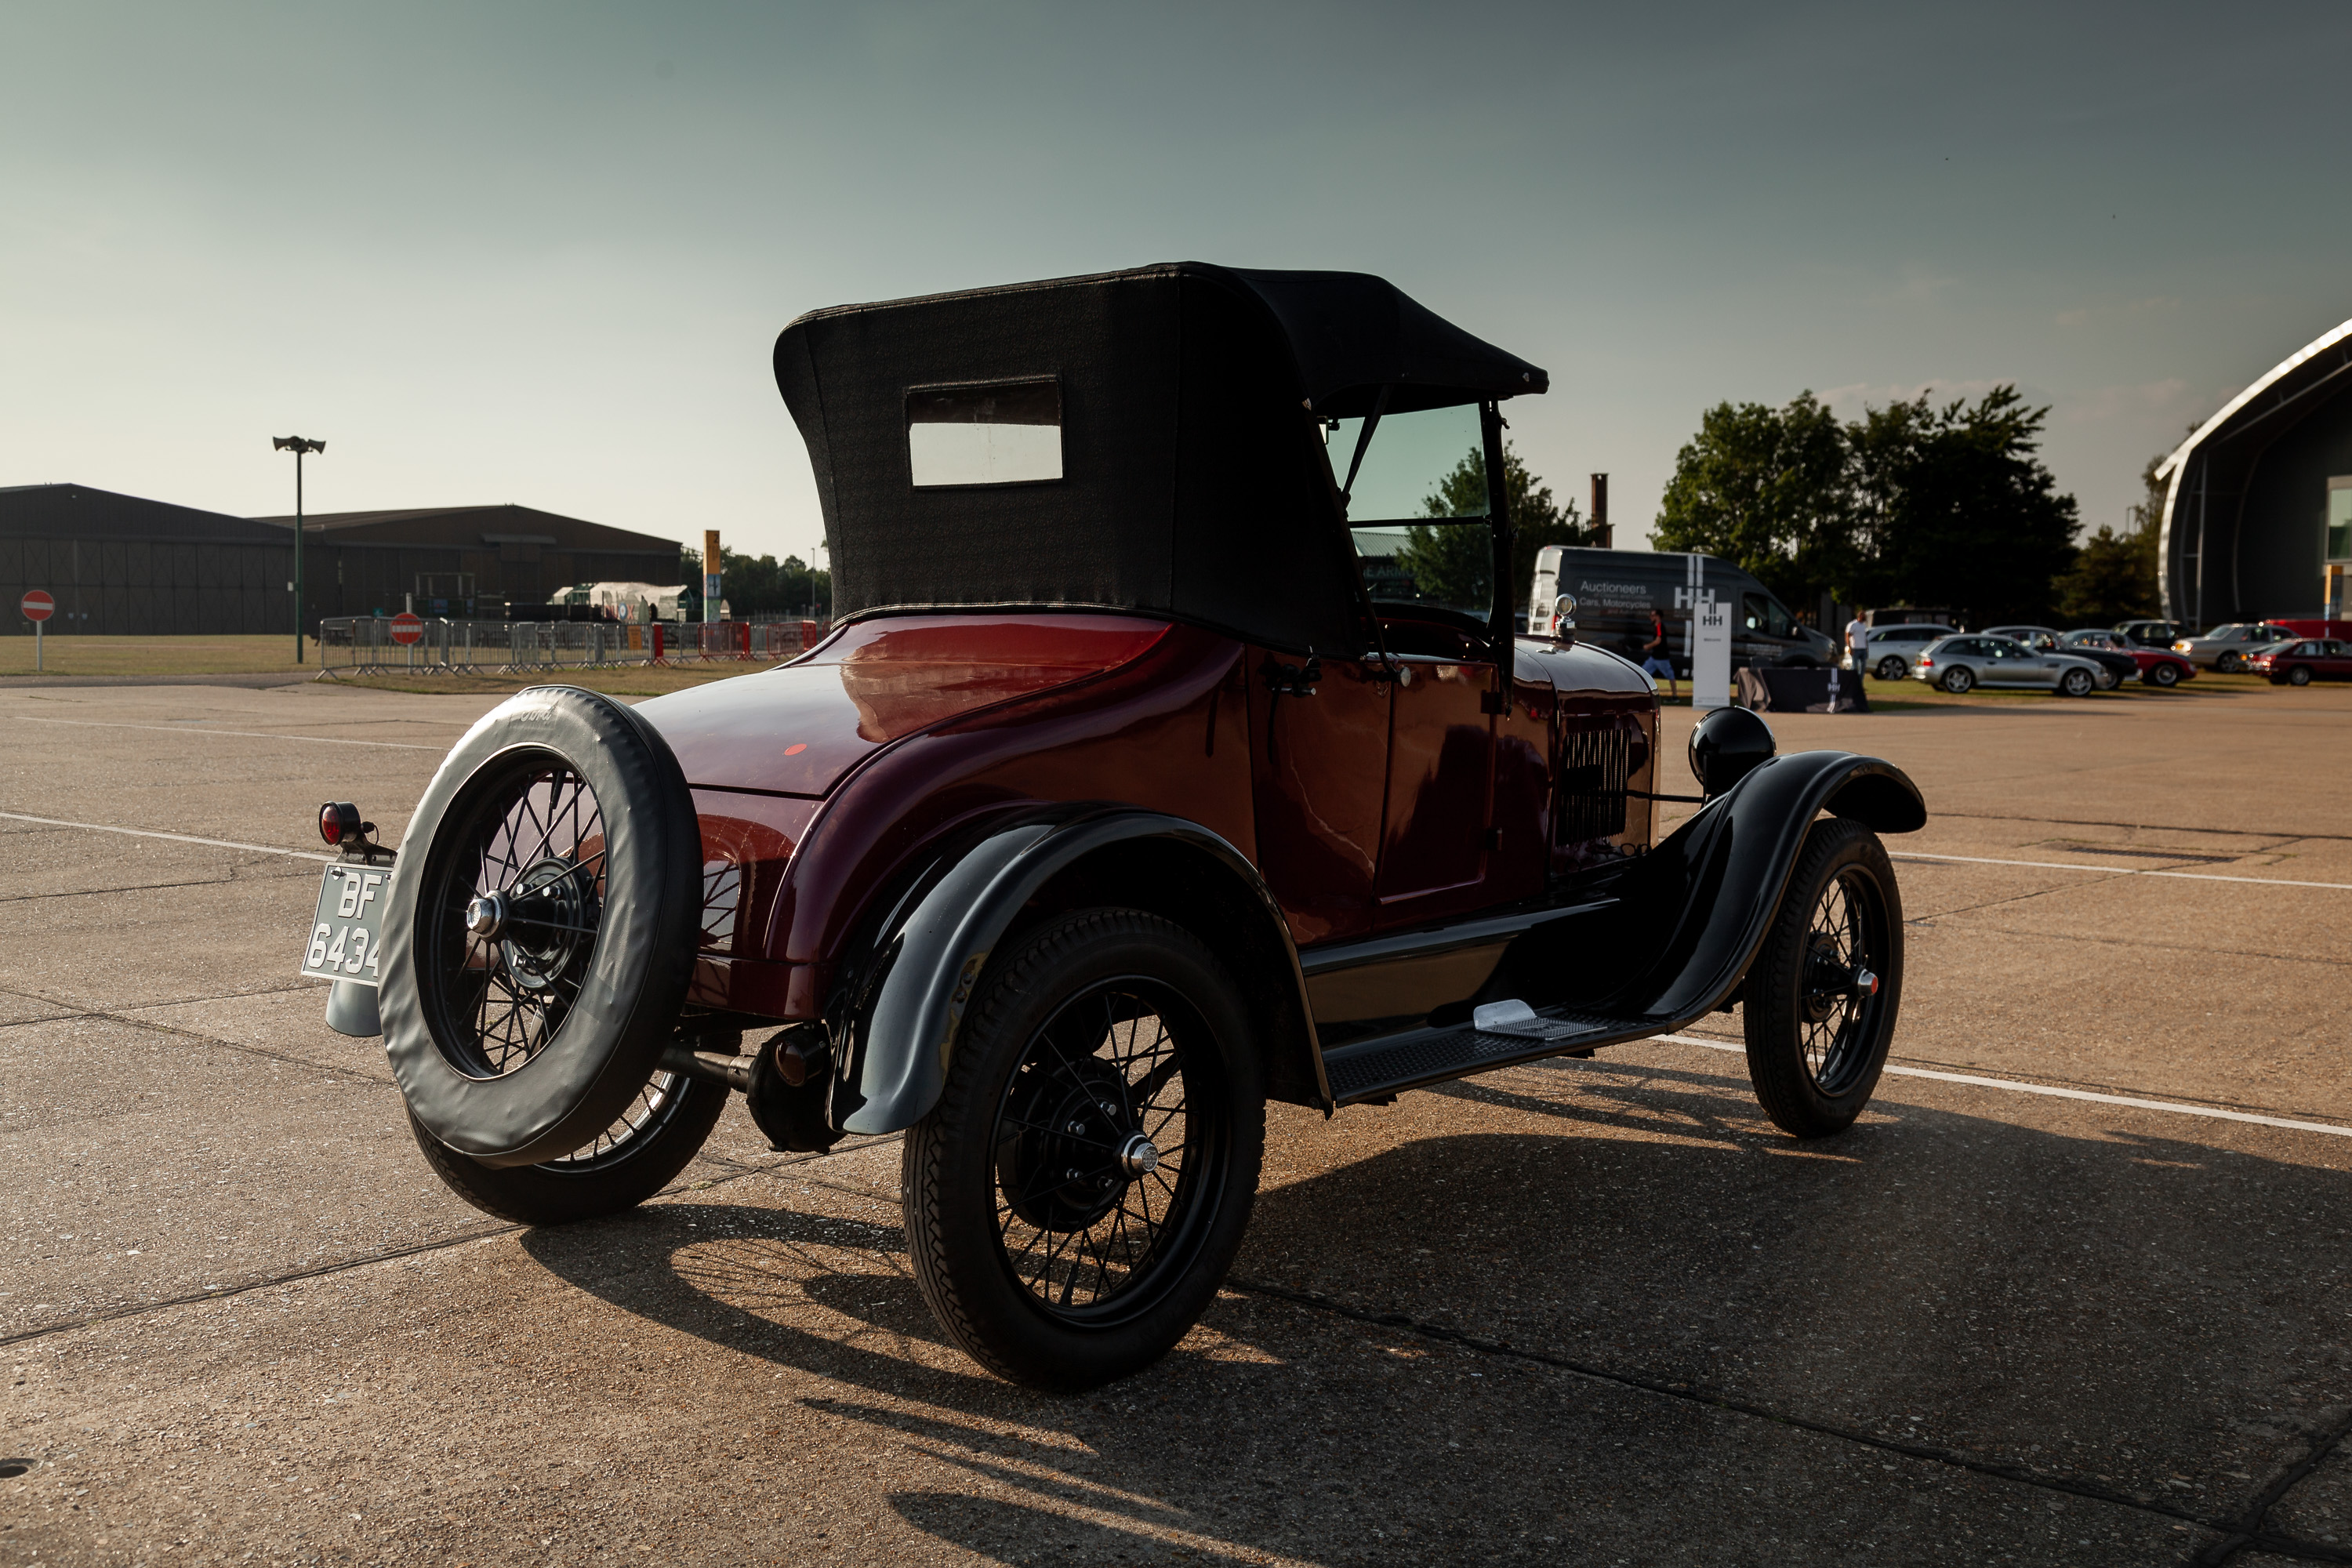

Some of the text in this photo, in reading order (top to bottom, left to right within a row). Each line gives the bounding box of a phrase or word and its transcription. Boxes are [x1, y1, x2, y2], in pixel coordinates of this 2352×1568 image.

[1581, 580, 1646, 594] Auctioneers
[1579, 597, 1651, 609] Cars, Motorcycles
[338, 872, 383, 919] BF
[307, 923, 379, 978] 6434
